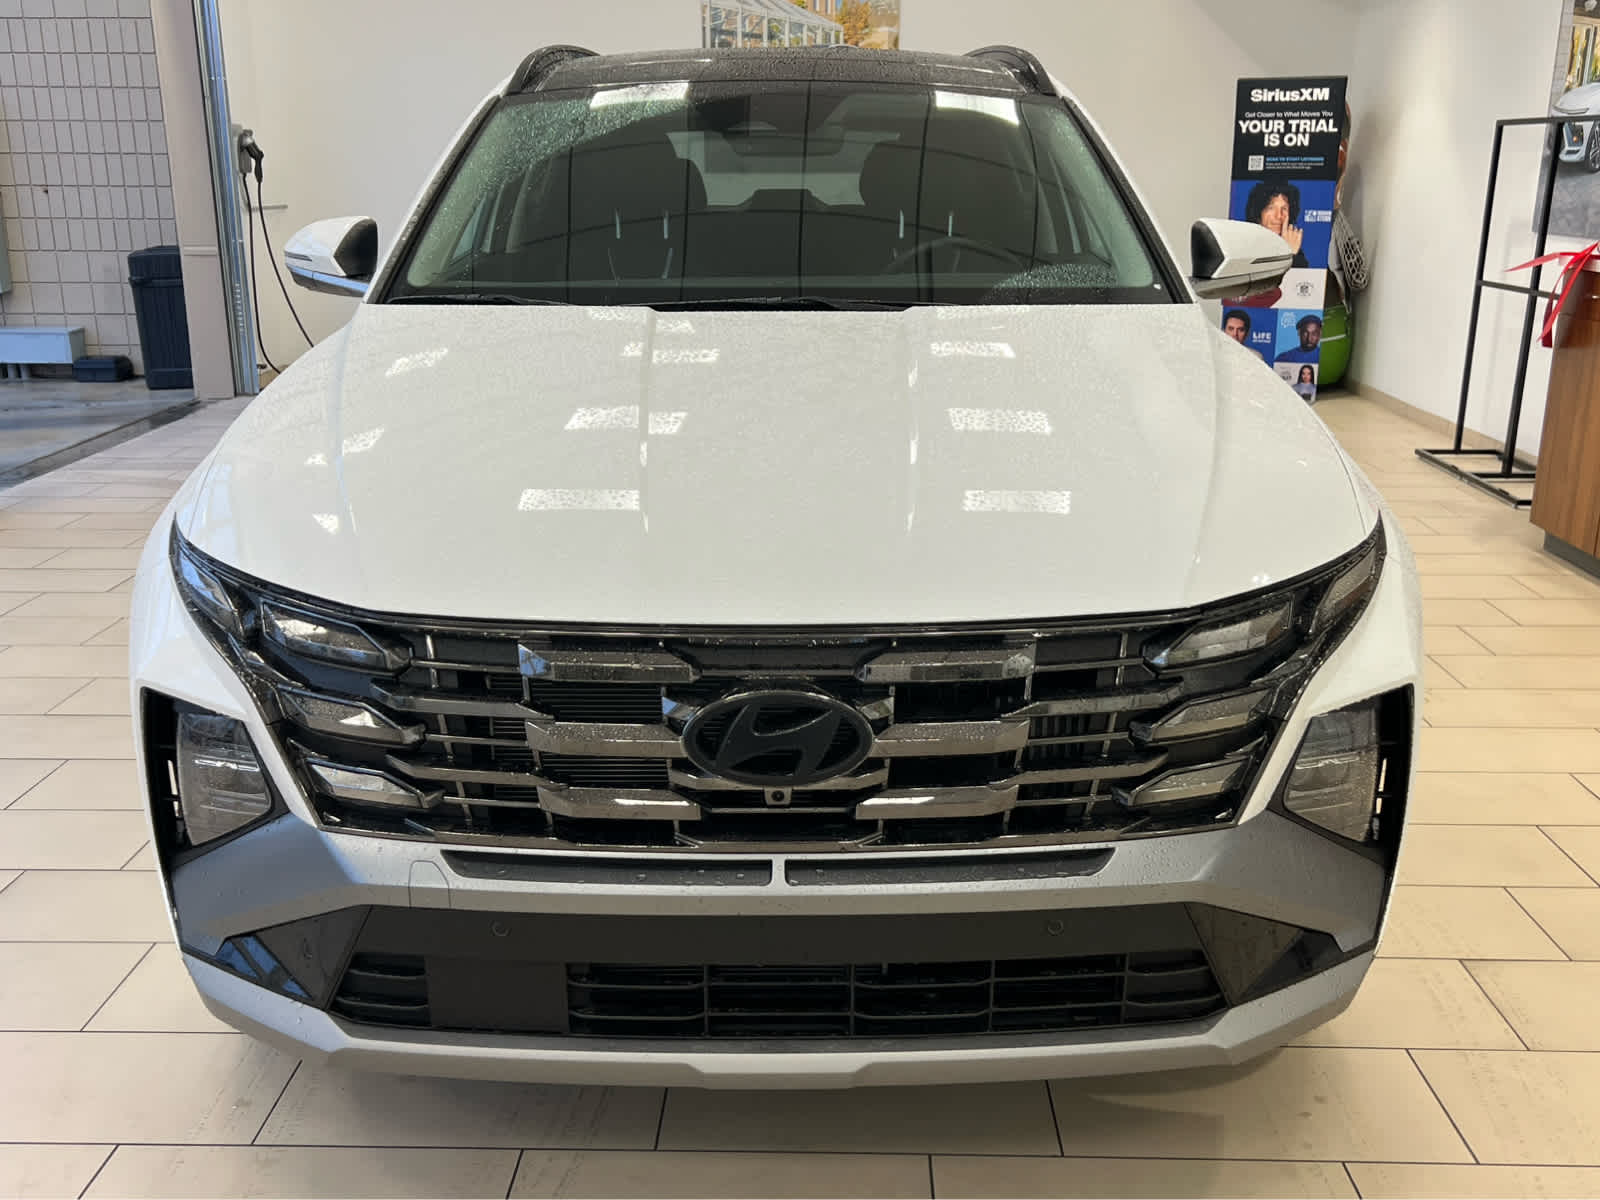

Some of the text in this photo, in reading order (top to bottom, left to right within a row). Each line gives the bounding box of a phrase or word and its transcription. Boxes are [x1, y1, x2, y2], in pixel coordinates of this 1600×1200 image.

[1250, 88, 1330, 102] SiriusXM
[1239, 119, 1338, 133] YOUR TRIAL
[1264, 133, 1310, 147] IS ON
